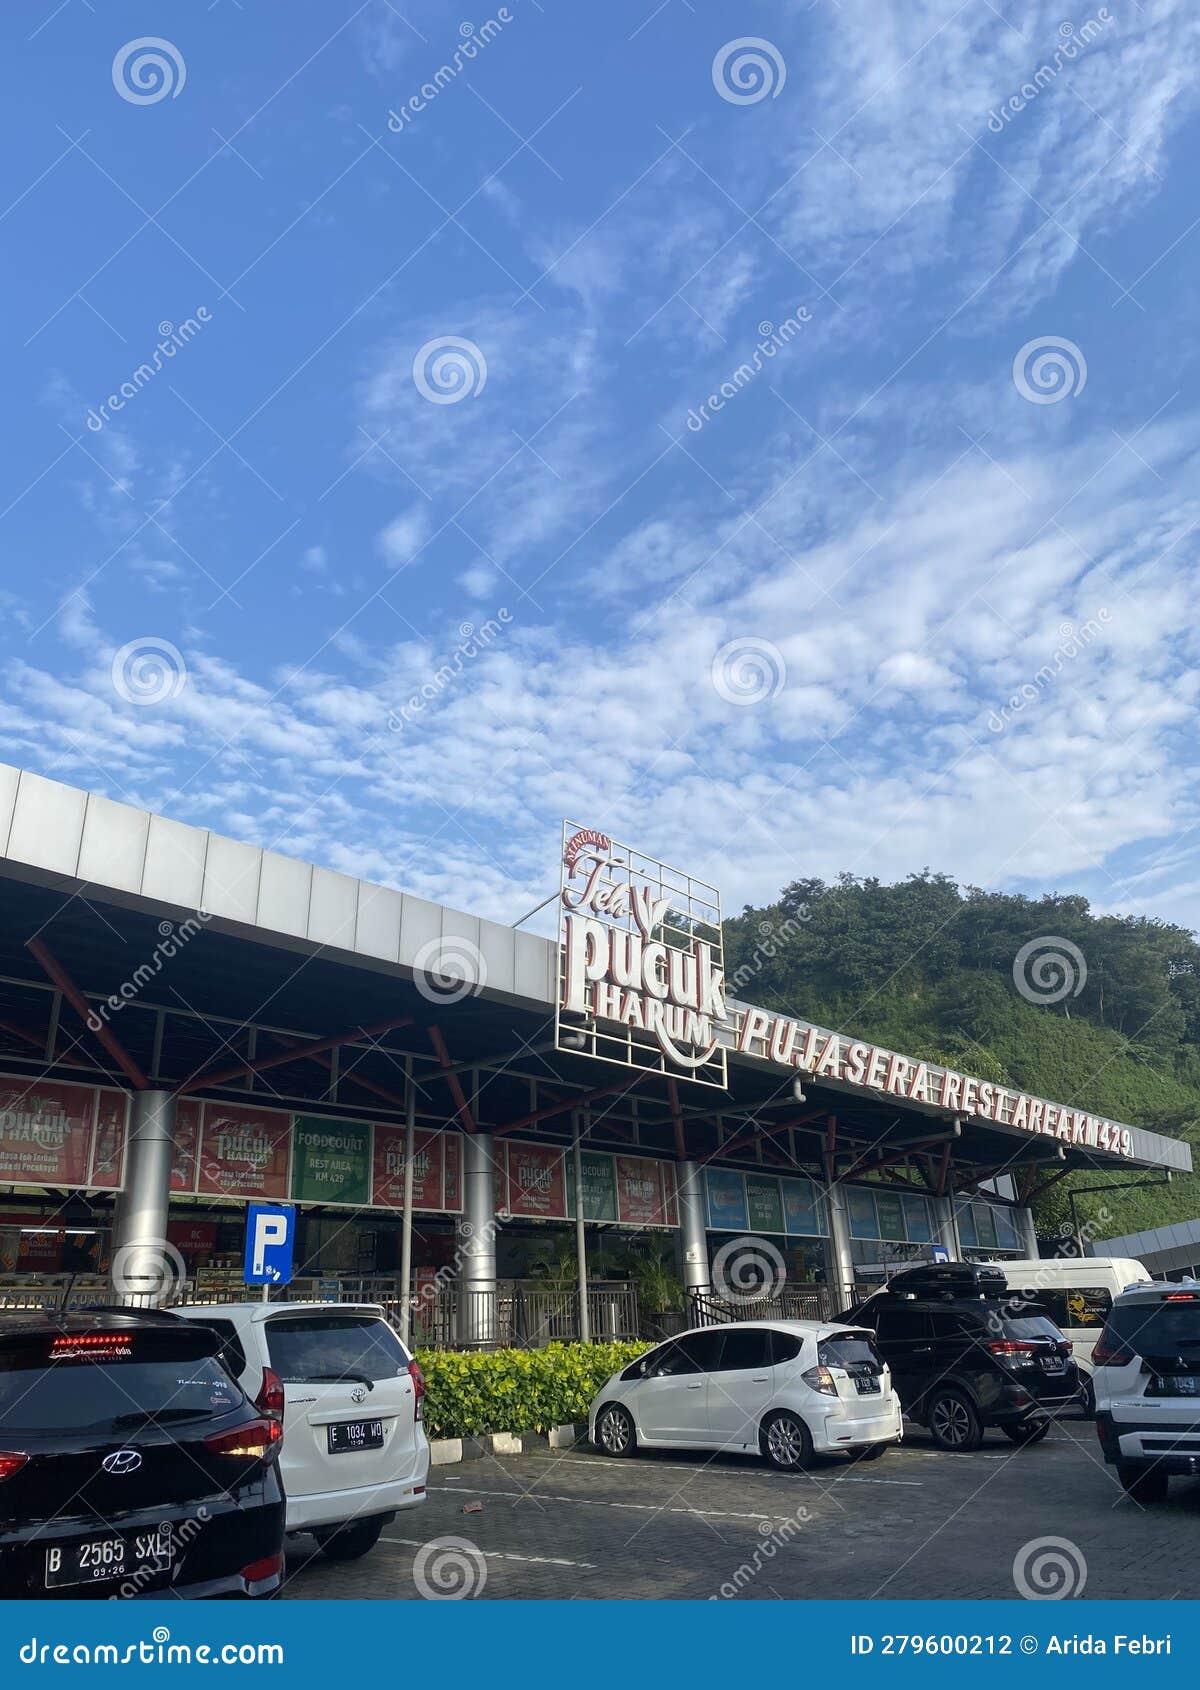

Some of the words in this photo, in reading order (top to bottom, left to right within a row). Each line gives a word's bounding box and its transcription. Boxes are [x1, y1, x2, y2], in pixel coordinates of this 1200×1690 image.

[566, 830, 610, 866] MINUMAN
[592, 980, 719, 1068] HARUM
[737, 1008, 928, 1102] PUJASERA
[940, 1071, 1008, 1121] REST
[1010, 1095, 1072, 1144] AREA
[1098, 1121, 1131, 1156] 429
[298, 1132, 364, 1151] FOODCOURT
[309, 1158, 329, 1169] REST
[330, 1159, 352, 1172] AREA
[315, 1171, 328, 1182] KM
[329, 1173, 345, 1184] 429
[253, 1214, 287, 1275] P
[331, 1427, 338, 1442] E
[346, 1424, 366, 1440] 1034
[49, 1548, 61, 1572] B
[79, 1538, 125, 1568] 2565
[135, 1533, 167, 1559] SXL
